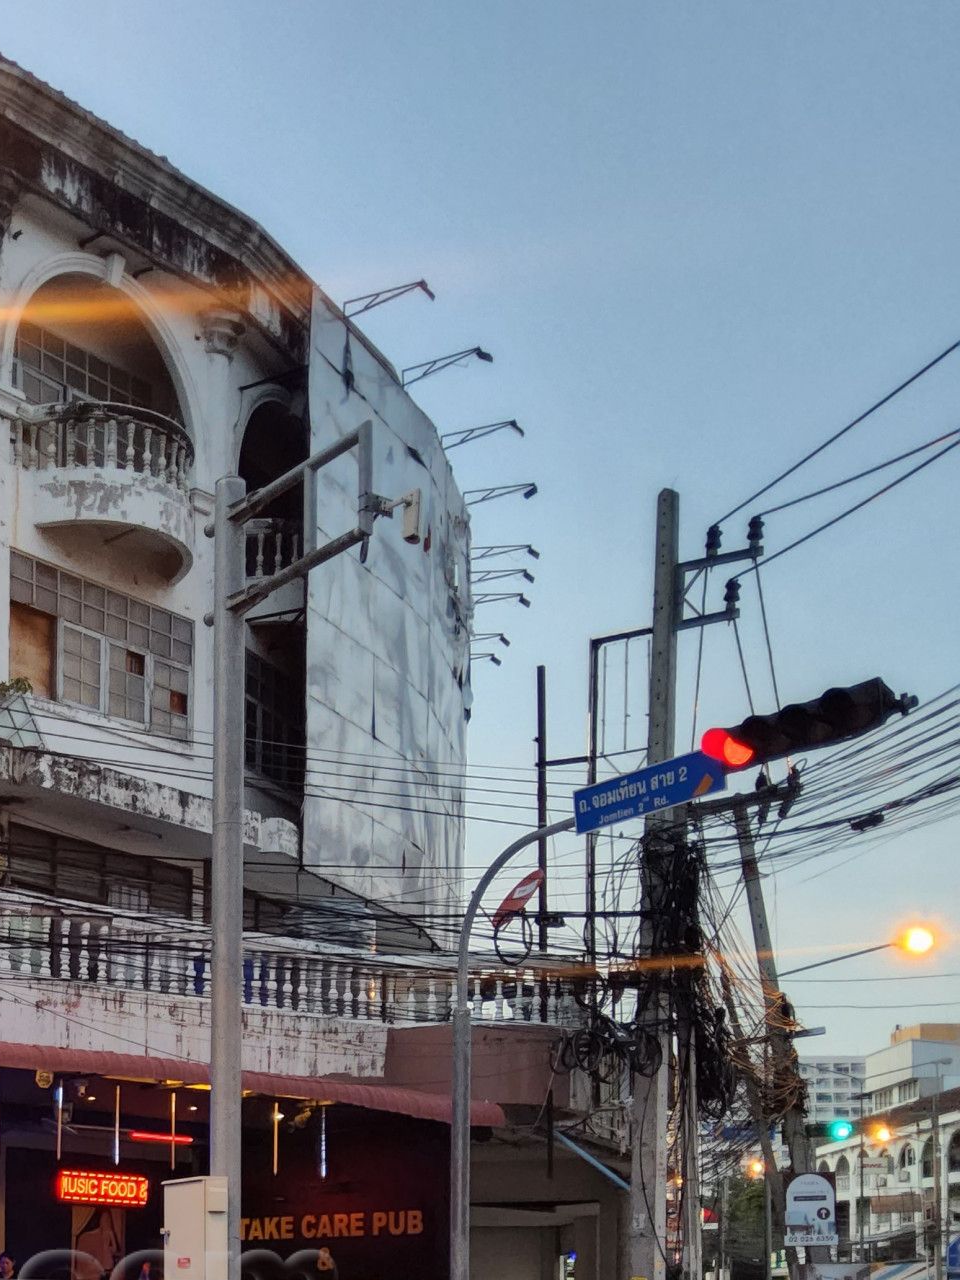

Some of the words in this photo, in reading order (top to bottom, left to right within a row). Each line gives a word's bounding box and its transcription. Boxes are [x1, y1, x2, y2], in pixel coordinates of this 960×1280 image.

[650, 770, 674, 789] สาย
[679, 766, 688, 783] 2
[598, 806, 634, 824] Jomtien
[654, 796, 669, 807] Rd.
[101, 1180, 137, 1197] FOOD
[240, 1216, 294, 1241] TAKE
[301, 1213, 365, 1239] CARE
[372, 1210, 424, 1236] PUB
